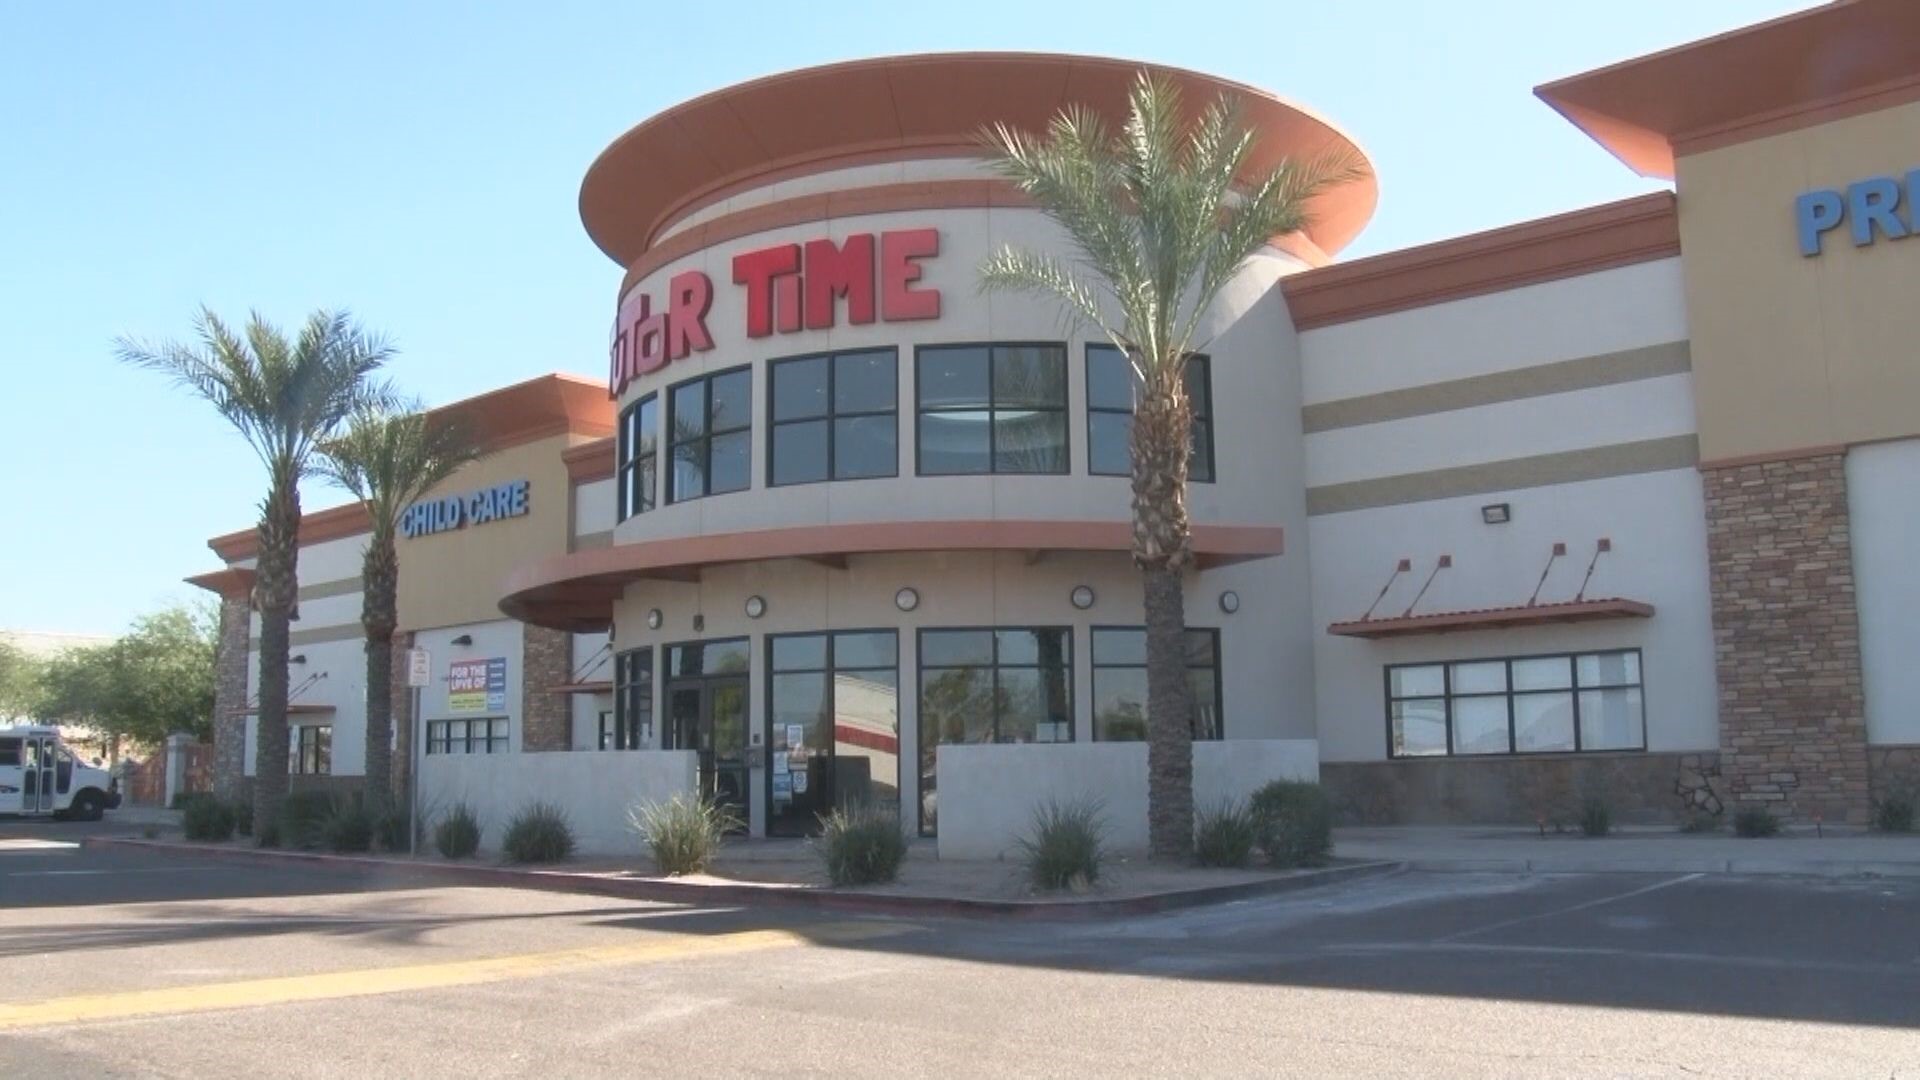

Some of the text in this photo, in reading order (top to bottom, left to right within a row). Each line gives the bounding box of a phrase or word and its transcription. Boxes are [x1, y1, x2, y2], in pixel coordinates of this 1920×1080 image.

[401, 479, 529, 538] CHILD CARE
[451, 666, 468, 678] FOR
[470, 664, 487, 676] THE
[474, 677, 486, 689] OF
